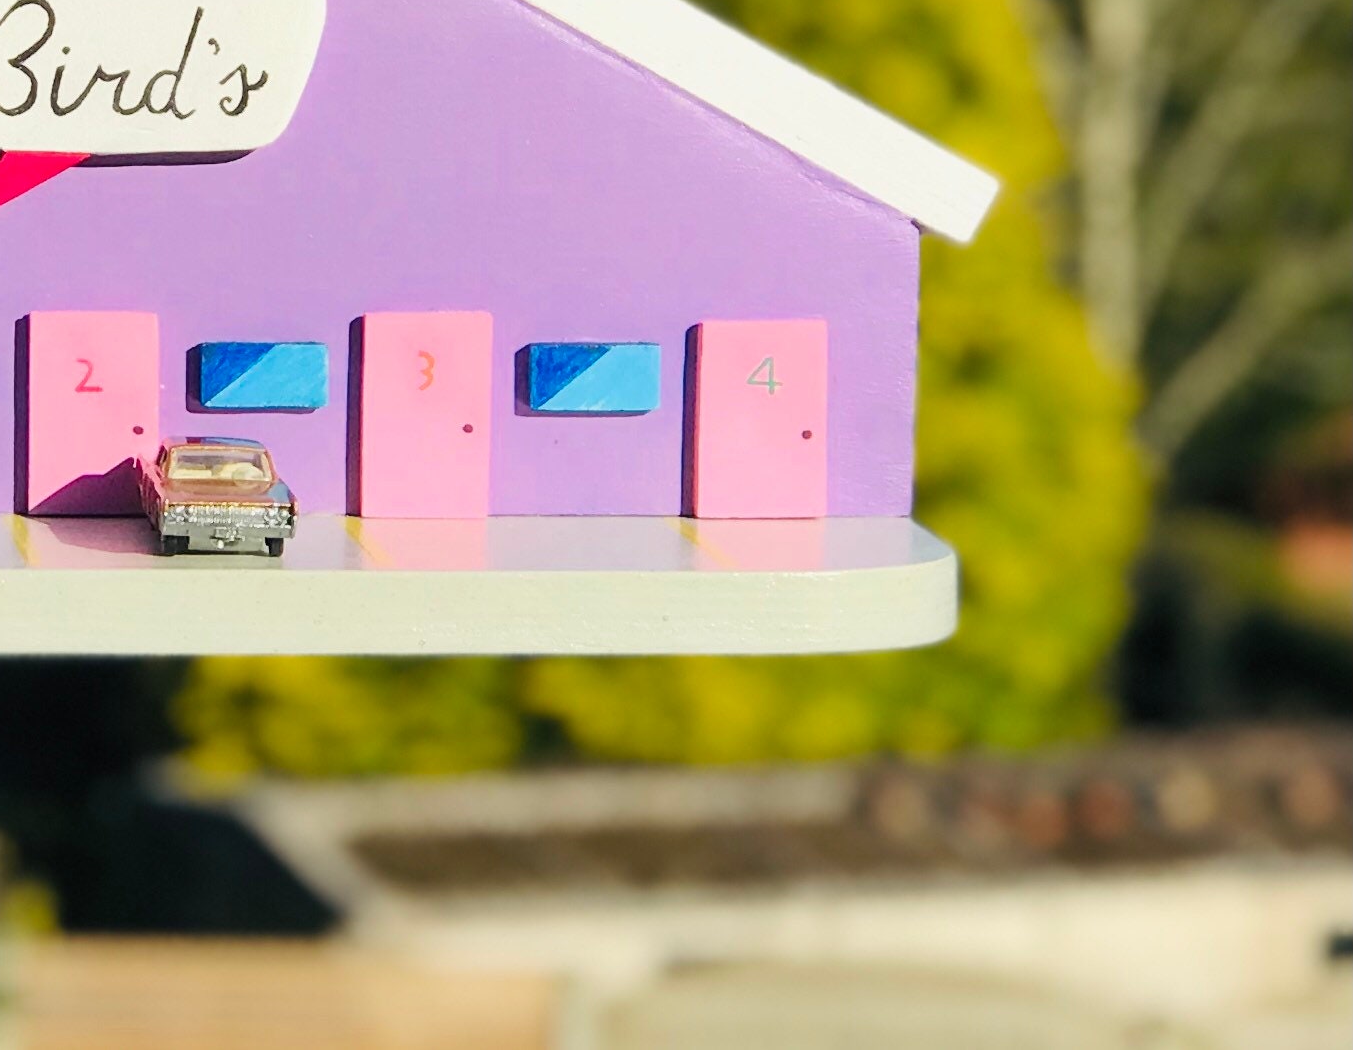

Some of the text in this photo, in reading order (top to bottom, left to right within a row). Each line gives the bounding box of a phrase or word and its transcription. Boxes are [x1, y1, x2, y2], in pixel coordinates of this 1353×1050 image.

[74, 357, 103, 394] 2
[417, 350, 436, 391] 3
[746, 356, 783, 395] 4
